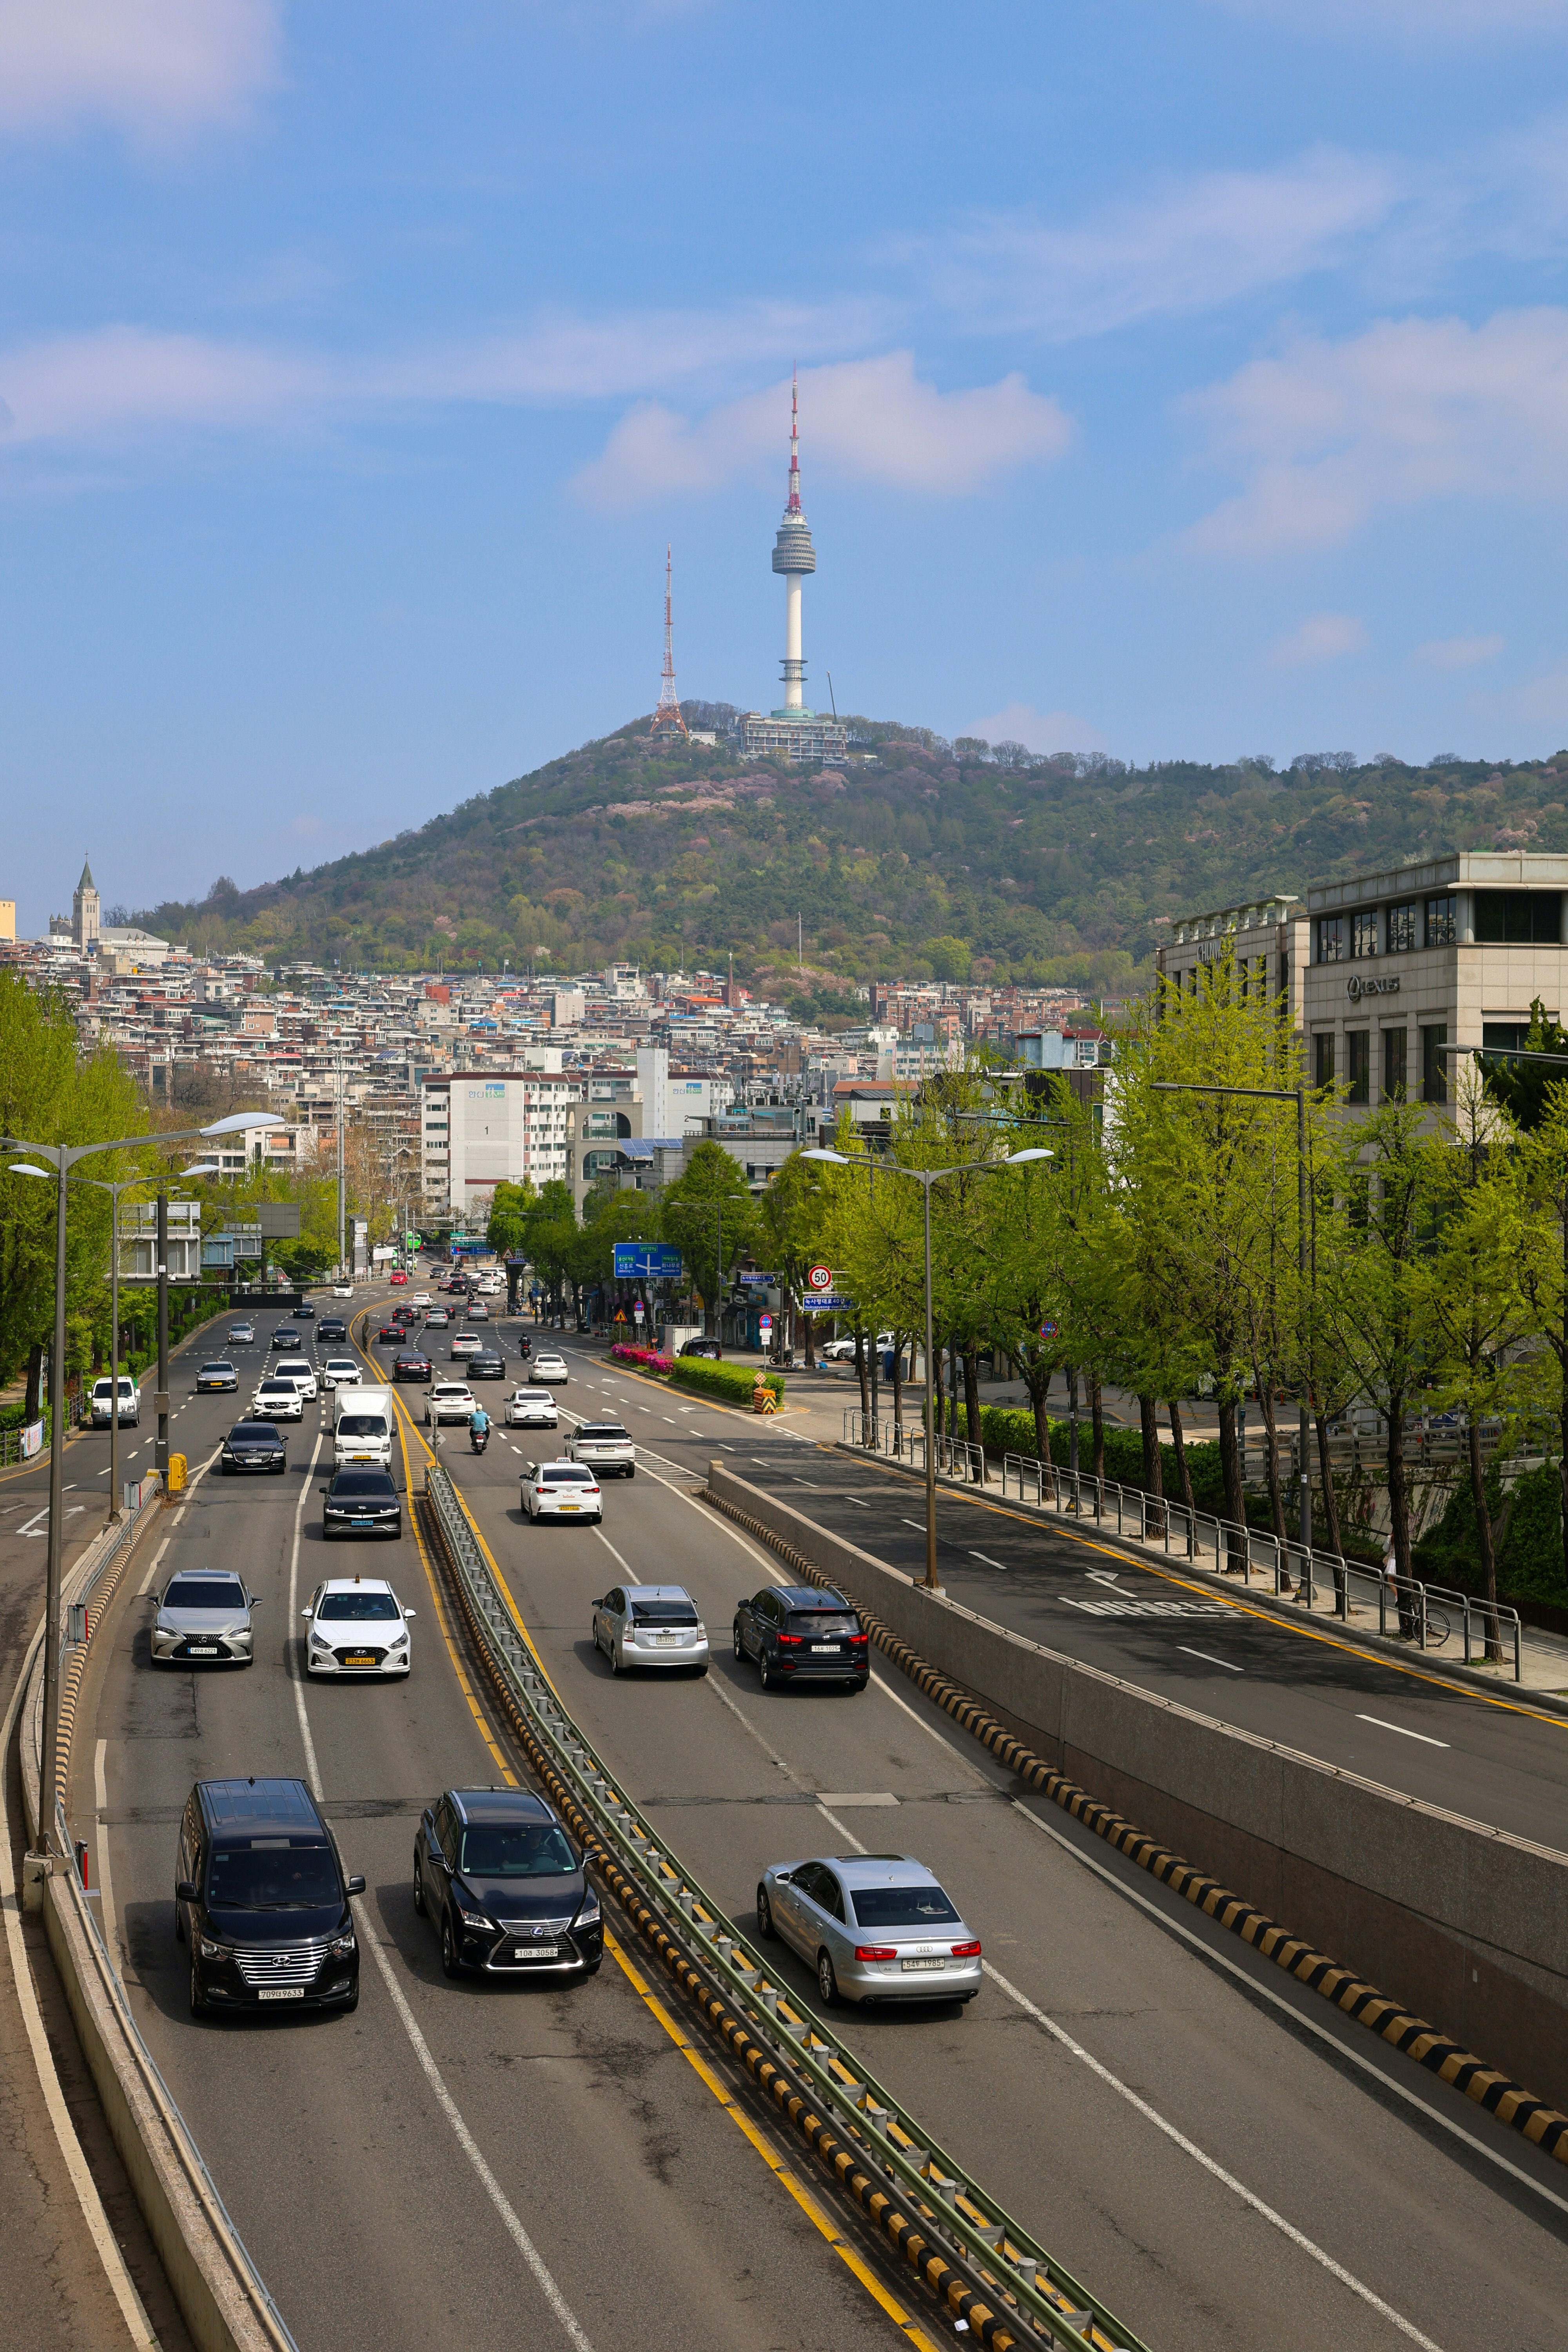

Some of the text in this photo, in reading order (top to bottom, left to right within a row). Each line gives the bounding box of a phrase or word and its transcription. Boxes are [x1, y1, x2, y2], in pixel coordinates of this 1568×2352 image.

[1361, 977, 1399, 995] LEXUS
[485, 1126, 488, 1135] 1
[815, 1272, 826, 1283] 50
[282, 1989, 302, 1998] 9633
